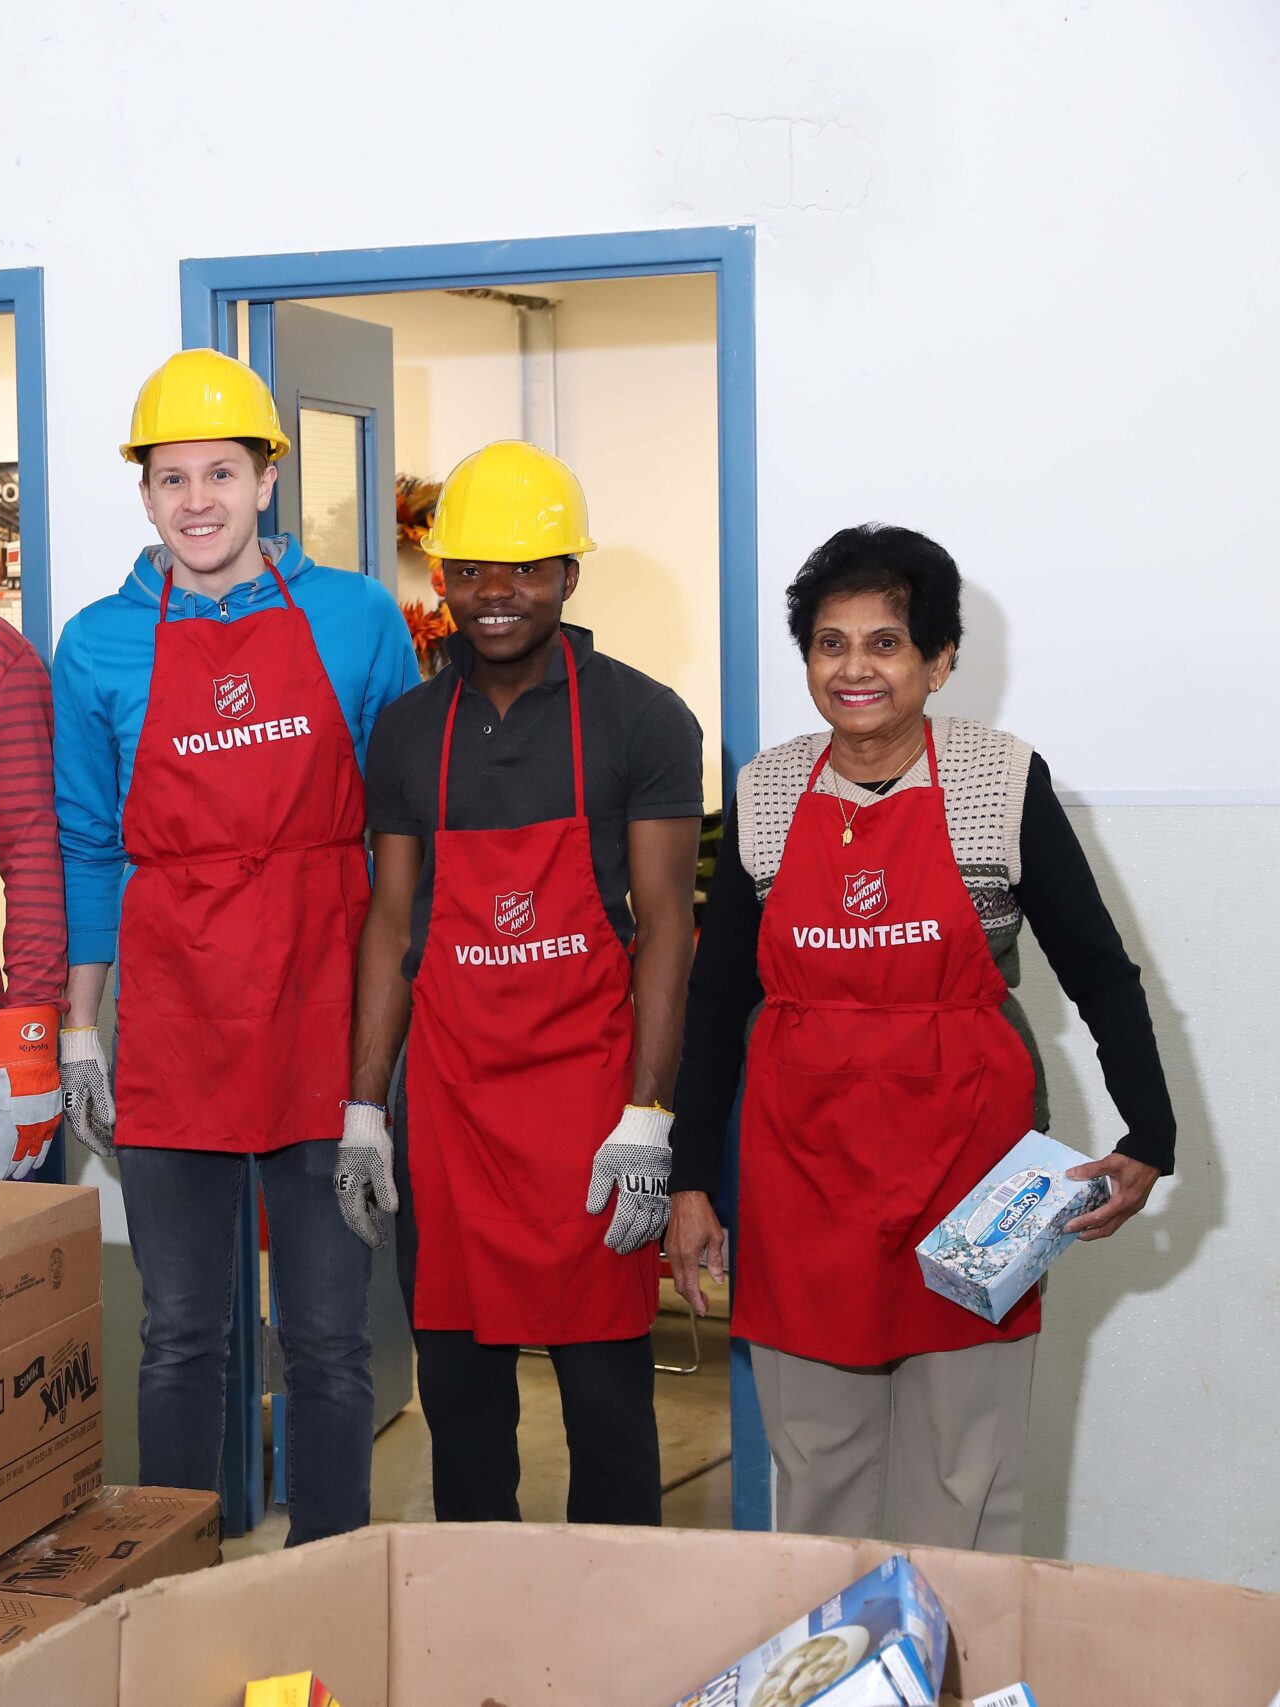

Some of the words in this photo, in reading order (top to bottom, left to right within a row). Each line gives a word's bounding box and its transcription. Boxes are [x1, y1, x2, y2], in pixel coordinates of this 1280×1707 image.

[217, 680, 248, 711] SALVATION
[220, 679, 234, 695] THE
[231, 693, 249, 715] ARMY
[172, 716, 311, 756] VOLUNTEER
[846, 877, 881, 908] SALVATION
[852, 875, 867, 892] THE
[497, 898, 529, 927] SALVATION
[501, 896, 516, 911] THE
[859, 891, 882, 913] ARMY
[510, 910, 529, 931] ARMY
[792, 920, 942, 949] VOLUNTEER
[455, 933, 588, 965] VOLUNTEER
[625, 1174, 670, 1197] ULIN
[1001, 1193, 1039, 1230] Scotties
